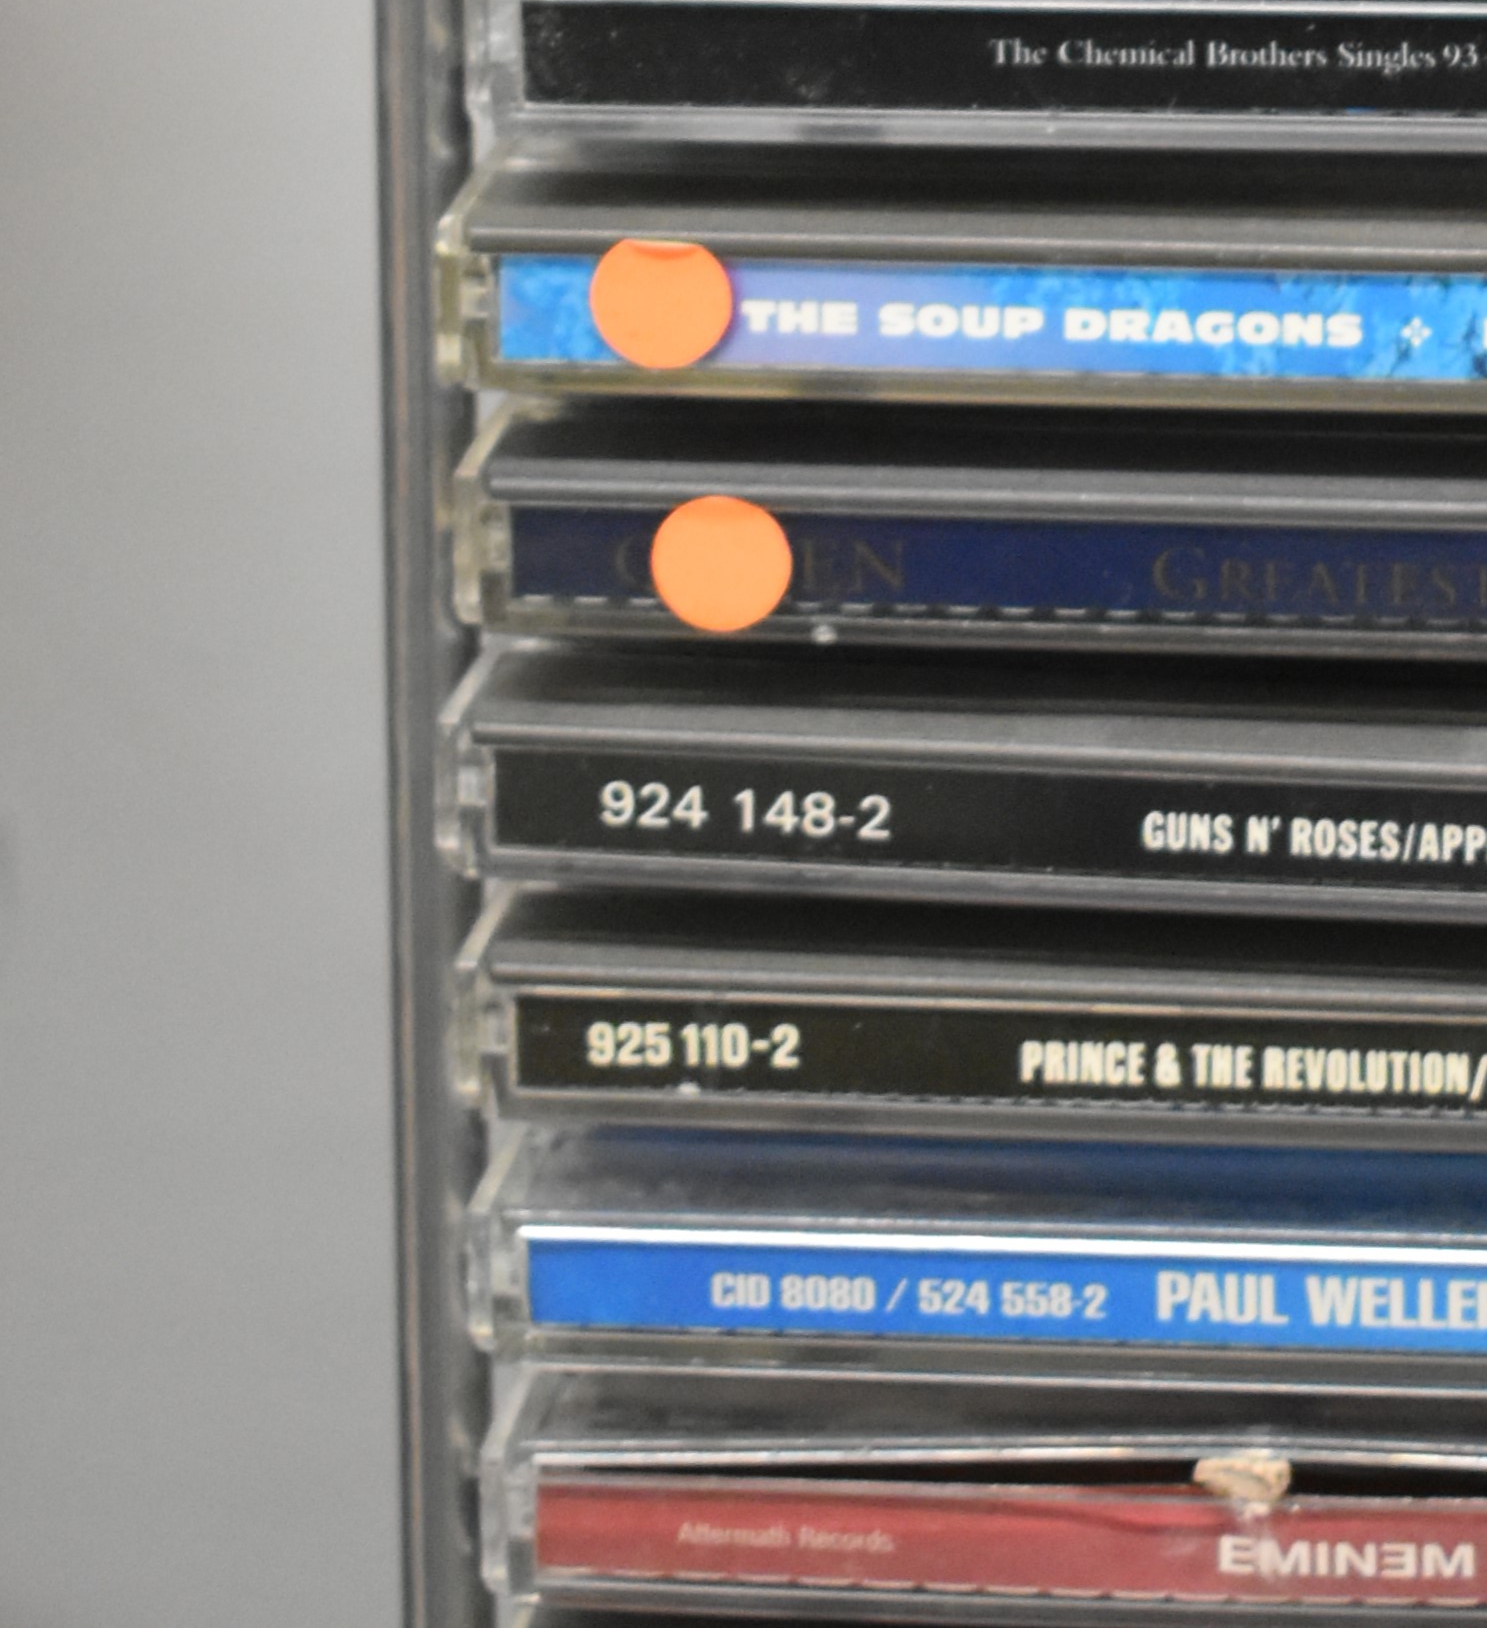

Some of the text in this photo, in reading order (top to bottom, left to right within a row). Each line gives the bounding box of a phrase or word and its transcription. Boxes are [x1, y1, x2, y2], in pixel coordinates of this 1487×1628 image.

[989, 40, 1047, 68] The
[1057, 40, 1195, 69] Chemical
[1206, 41, 1328, 70] Brothers
[1338, 42, 1435, 78] Singles
[1442, 44, 1478, 70] 93
[742, 300, 857, 335] THE
[879, 303, 1045, 337] SOUP
[1064, 309, 1363, 348] DRAGONS
[601, 782, 890, 841] 924 148-2
[1143, 813, 1234, 854] GUNS
[587, 1023, 800, 1068] 925 110-2
[1021, 1040, 1145, 1085] PRINCE
[1155, 1045, 1180, 1085] &
[1194, 1045, 1251, 1087] THE
[711, 1273, 770, 1310] CID
[781, 1276, 876, 1312] 8080
[918, 1279, 989, 1316] 524
[1003, 1282, 1107, 1320] 558-2
[1156, 1273, 1287, 1325] PAUL
[799, 1524, 895, 1553] Records
